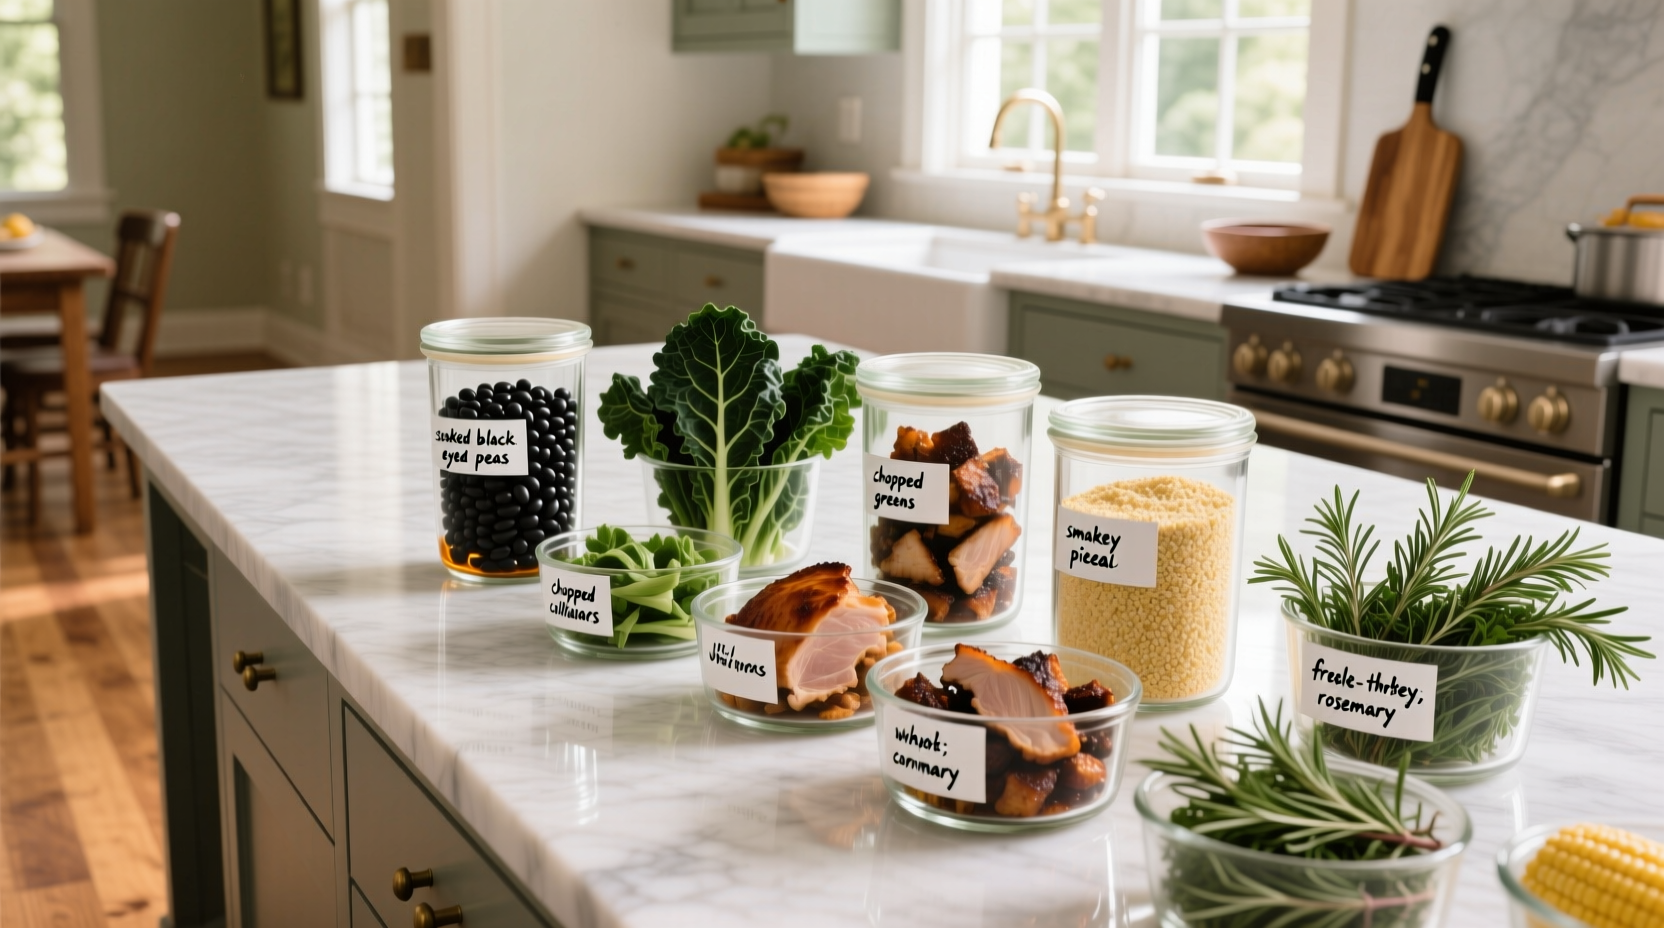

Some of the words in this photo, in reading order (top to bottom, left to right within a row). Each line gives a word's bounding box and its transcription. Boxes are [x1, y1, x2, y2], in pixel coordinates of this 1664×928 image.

[477, 428, 516, 446] black
[442, 449, 468, 469] eyed
[475, 453, 510, 471] peas
[873, 464, 924, 493] chopped
[874, 492, 915, 510] greens
[1317, 693, 1396, 728] rosemary
